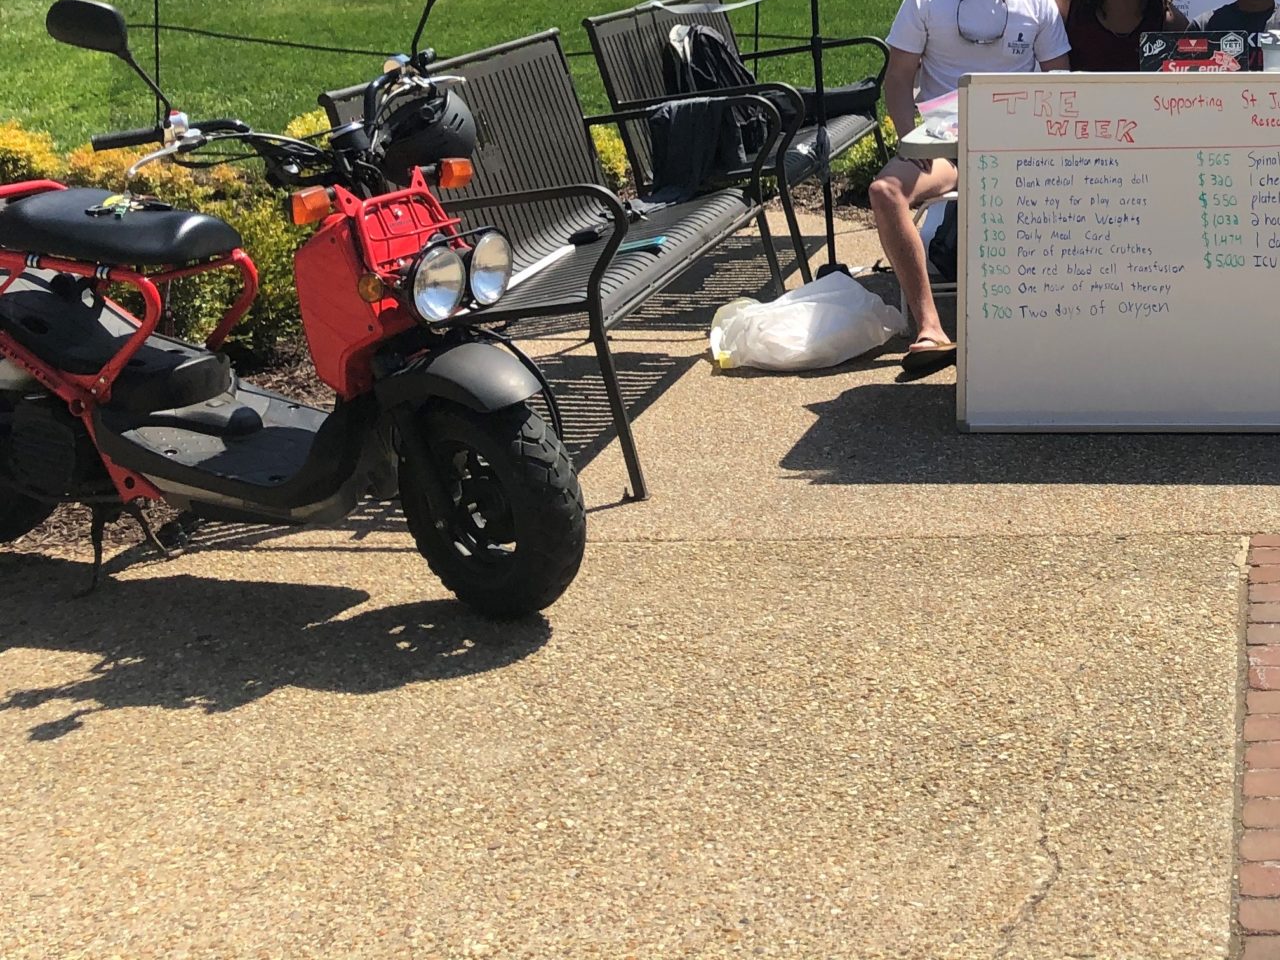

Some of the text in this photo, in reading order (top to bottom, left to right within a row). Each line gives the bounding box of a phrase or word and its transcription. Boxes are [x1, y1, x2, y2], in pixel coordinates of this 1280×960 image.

[1224, 42, 1241, 50] YETI
[993, 90, 1079, 118] TKE
[1046, 119, 1138, 143] WEEK
[978, 154, 999, 170] $3
[1016, 155, 1055, 171] pediatric
[980, 176, 999, 191] $7
[1015, 175, 1041, 188] Blank
[1084, 175, 1123, 187] teaching
[1131, 174, 1149, 184] doll
[980, 193, 1003, 207] $10
[1016, 195, 1037, 207] New
[1045, 196, 1060, 209] toy
[1069, 194, 1082, 205] for
[1119, 197, 1148, 207] areas
[984, 229, 1111, 242] $30 Daily Meal Card
[979, 245, 1006, 258] $100
[1017, 246, 1036, 257] Pair
[1043, 245, 1054, 257] of
[1061, 244, 1103, 259] pediatric
[981, 261, 1185, 278] $250 One red blood cell transfusion
[1253, 255, 1277, 269] ICU
[983, 282, 1011, 298] $500
[1018, 284, 1037, 294] One
[1072, 281, 1083, 292] of
[1090, 281, 1124, 294] physical
[1131, 280, 1172, 295] therapy
[982, 303, 1013, 320] $700
[1019, 305, 1048, 319] Two
[1054, 303, 1081, 321] days
[1090, 299, 1106, 316] of
